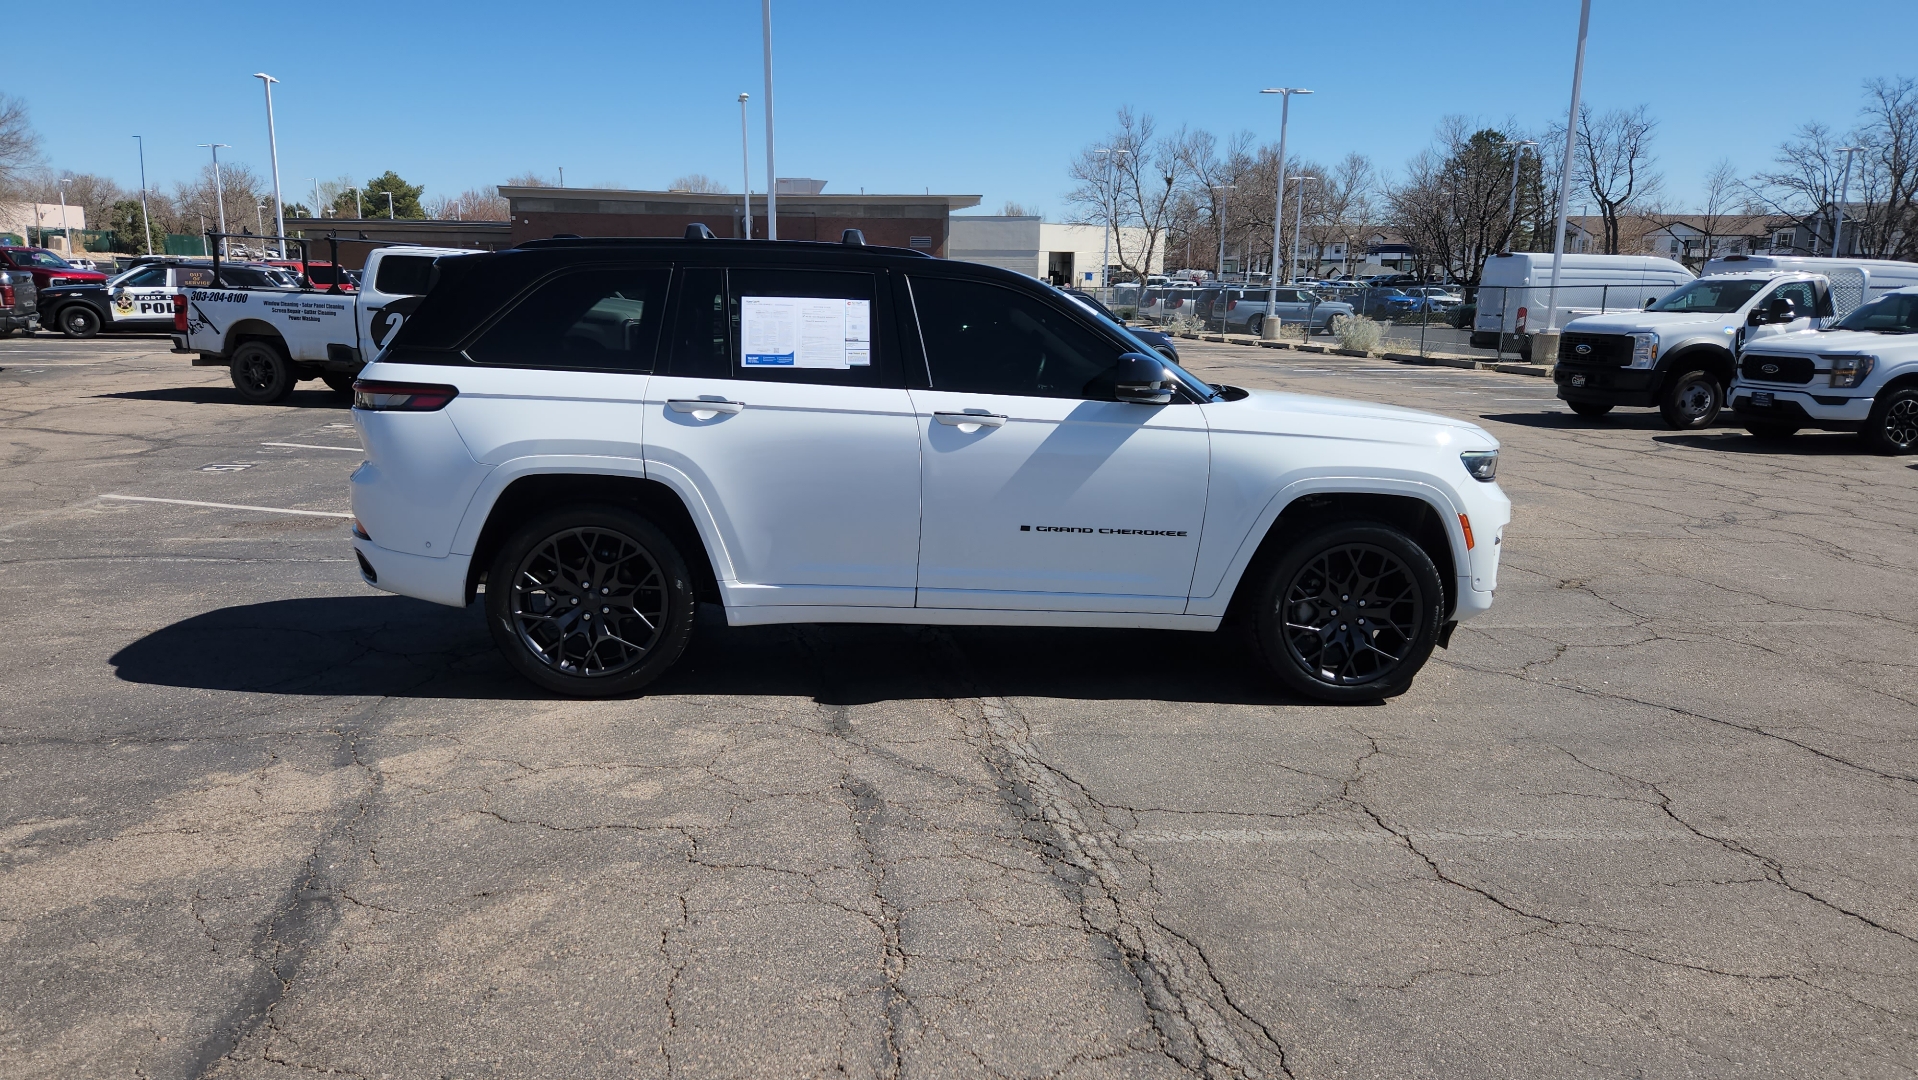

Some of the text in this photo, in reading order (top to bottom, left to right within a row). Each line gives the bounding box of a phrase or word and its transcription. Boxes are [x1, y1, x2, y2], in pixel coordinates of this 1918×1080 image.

[191, 291, 248, 303] 303-204-8100
[141, 303, 175, 314] POL
[380, 312, 411, 346] 2
[1098, 527, 1188, 537] CHEROKEE
